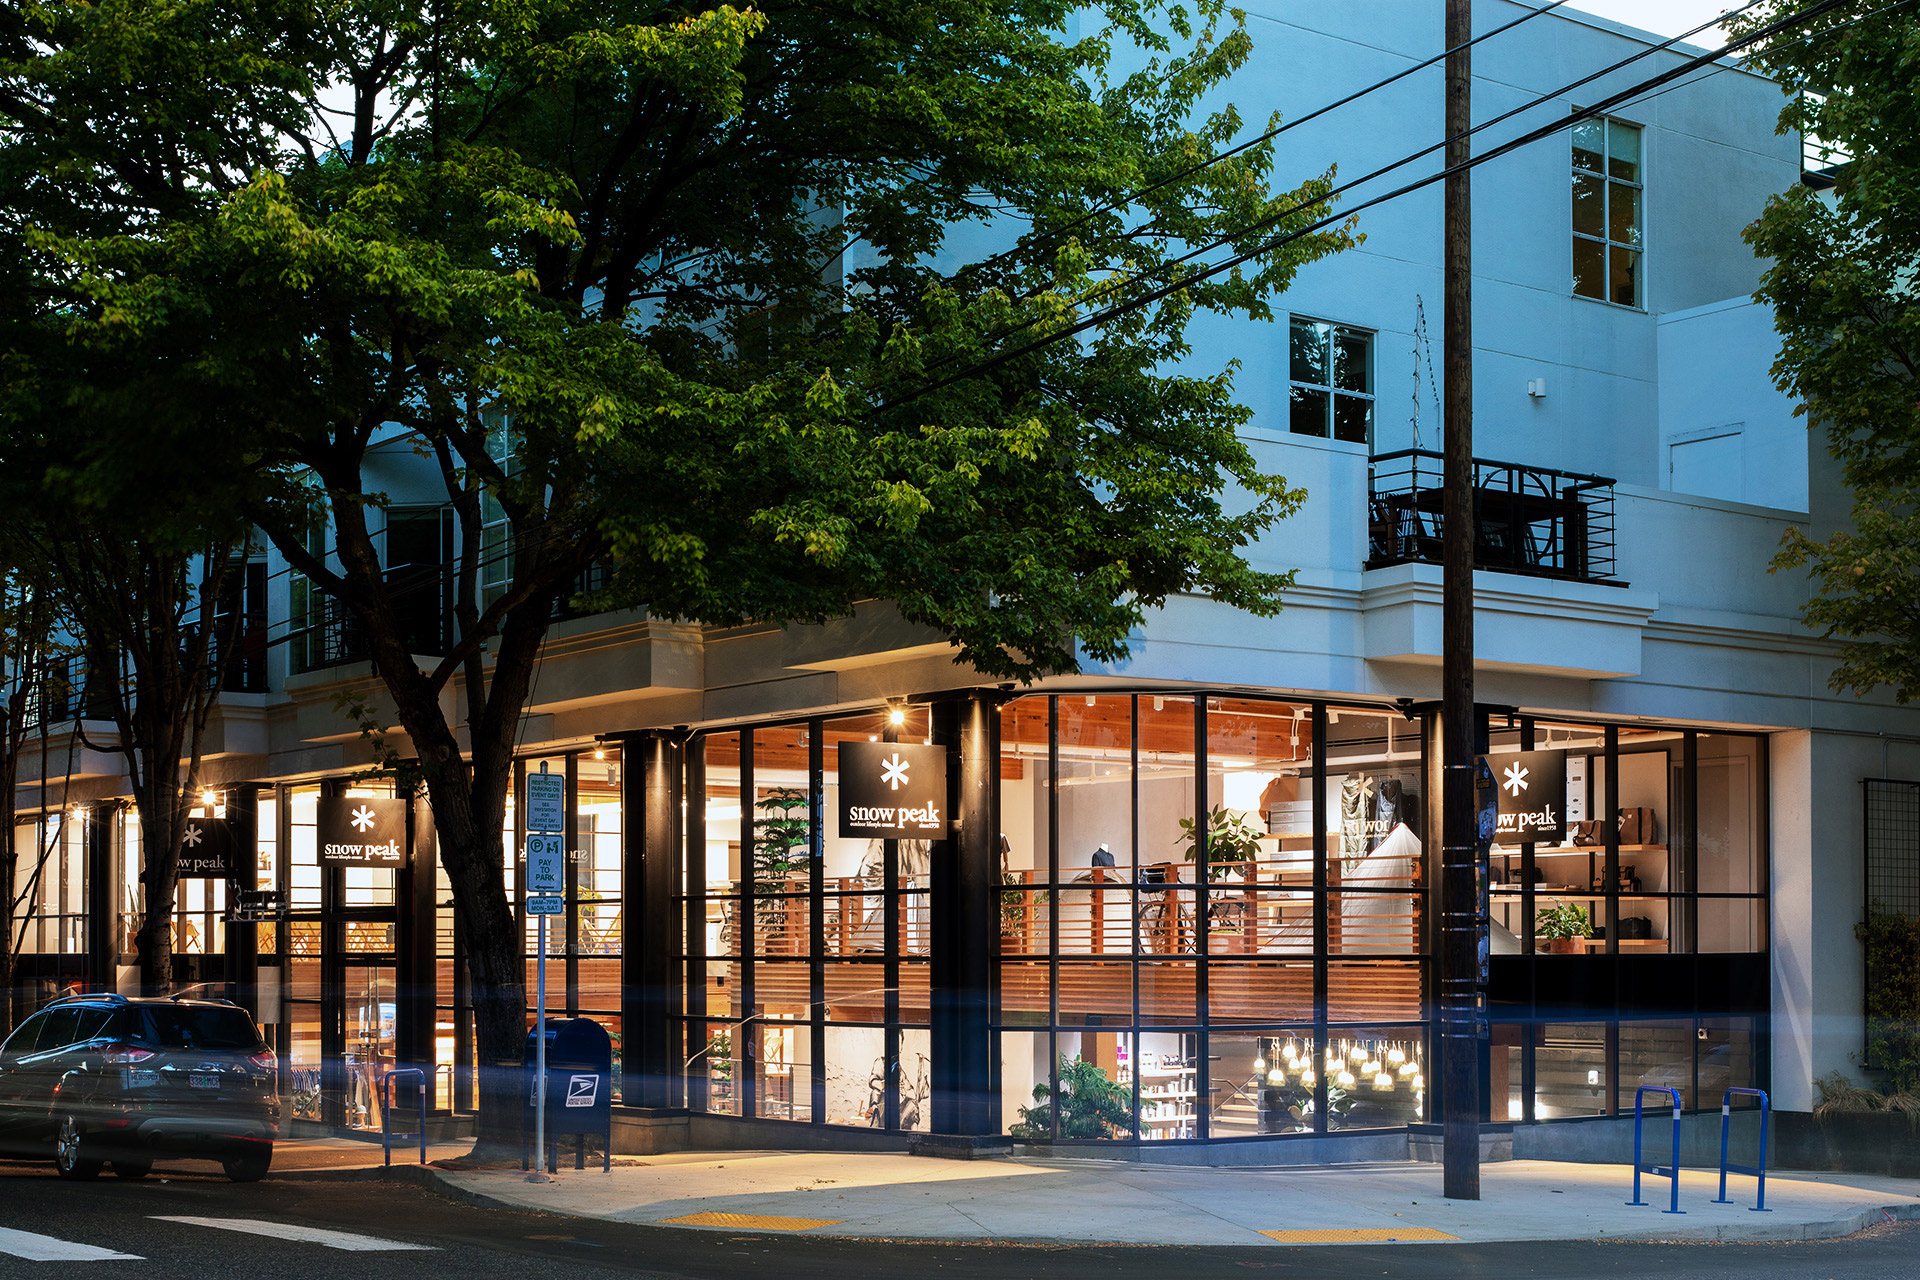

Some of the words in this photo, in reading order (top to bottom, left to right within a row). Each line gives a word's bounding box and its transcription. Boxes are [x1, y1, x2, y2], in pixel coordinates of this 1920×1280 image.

[849, 806, 896, 822] snow
[897, 800, 940, 828] peak
[1518, 804, 1556, 832] peak
[324, 844, 363, 855] snow
[364, 839, 400, 860] peak
[193, 854, 225, 872] peak
